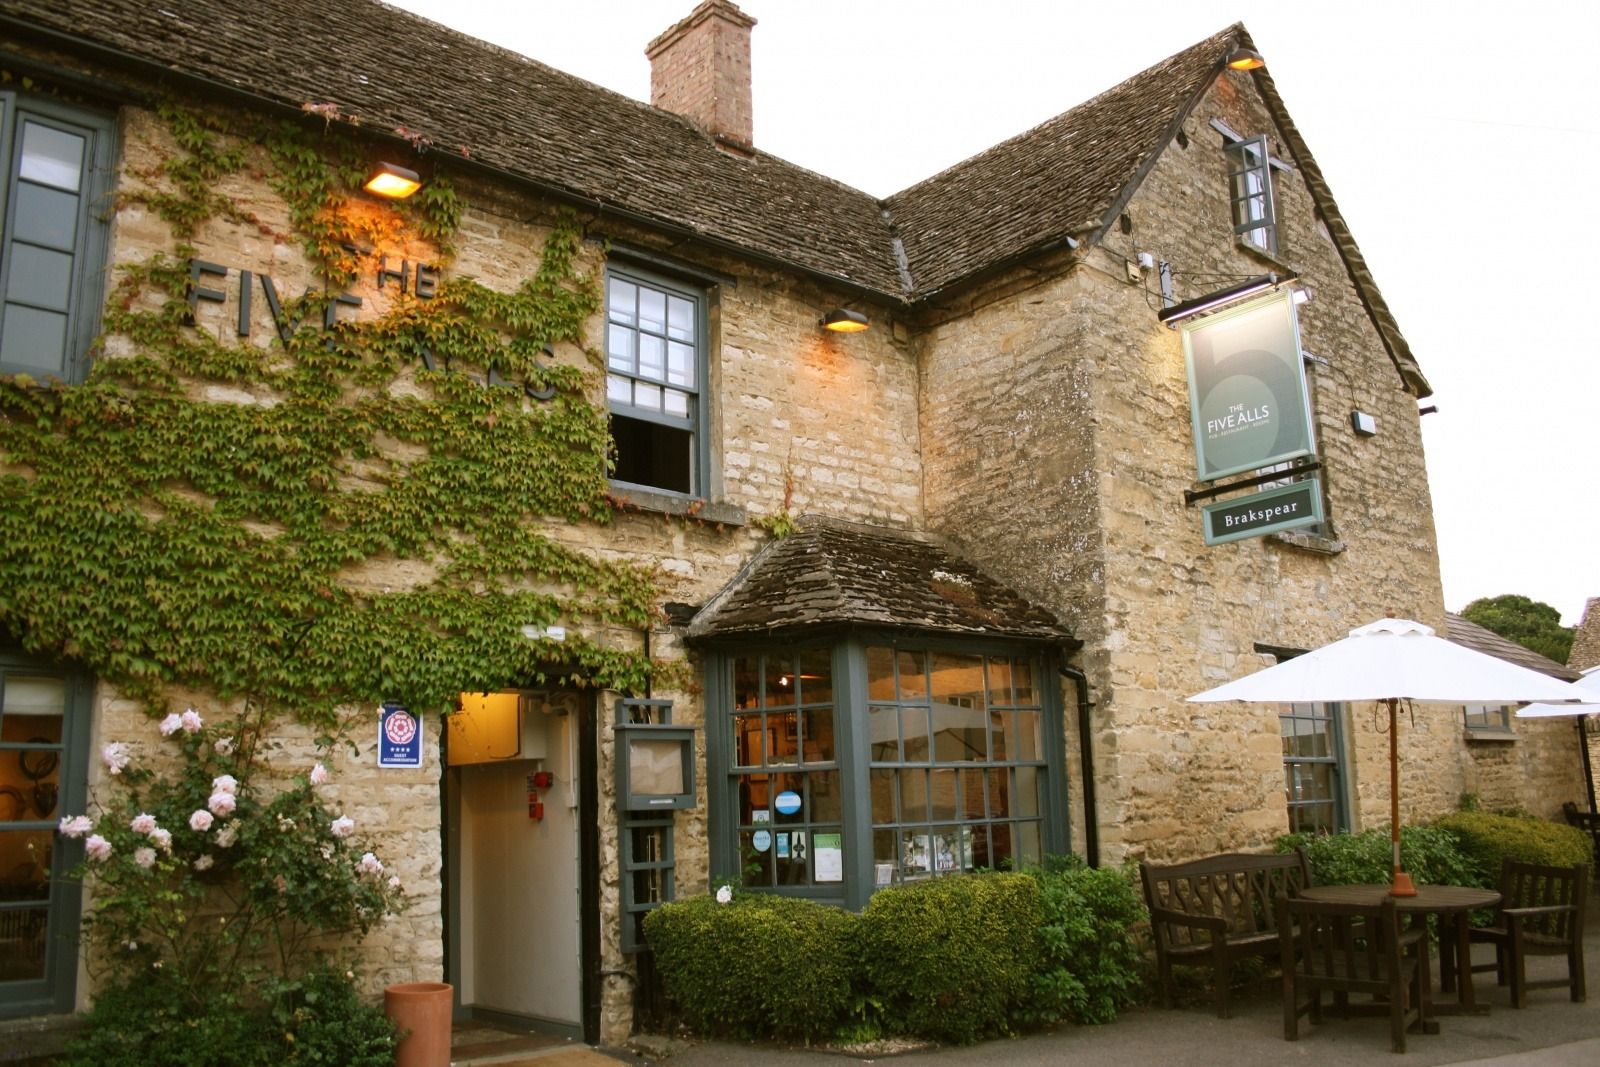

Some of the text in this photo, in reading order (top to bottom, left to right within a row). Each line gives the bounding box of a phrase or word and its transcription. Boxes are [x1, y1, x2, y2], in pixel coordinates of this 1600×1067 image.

[1207, 404, 1270, 434] FIVE ALLS
[1229, 403, 1244, 413] THE
[1224, 502, 1298, 527] Brakspear
